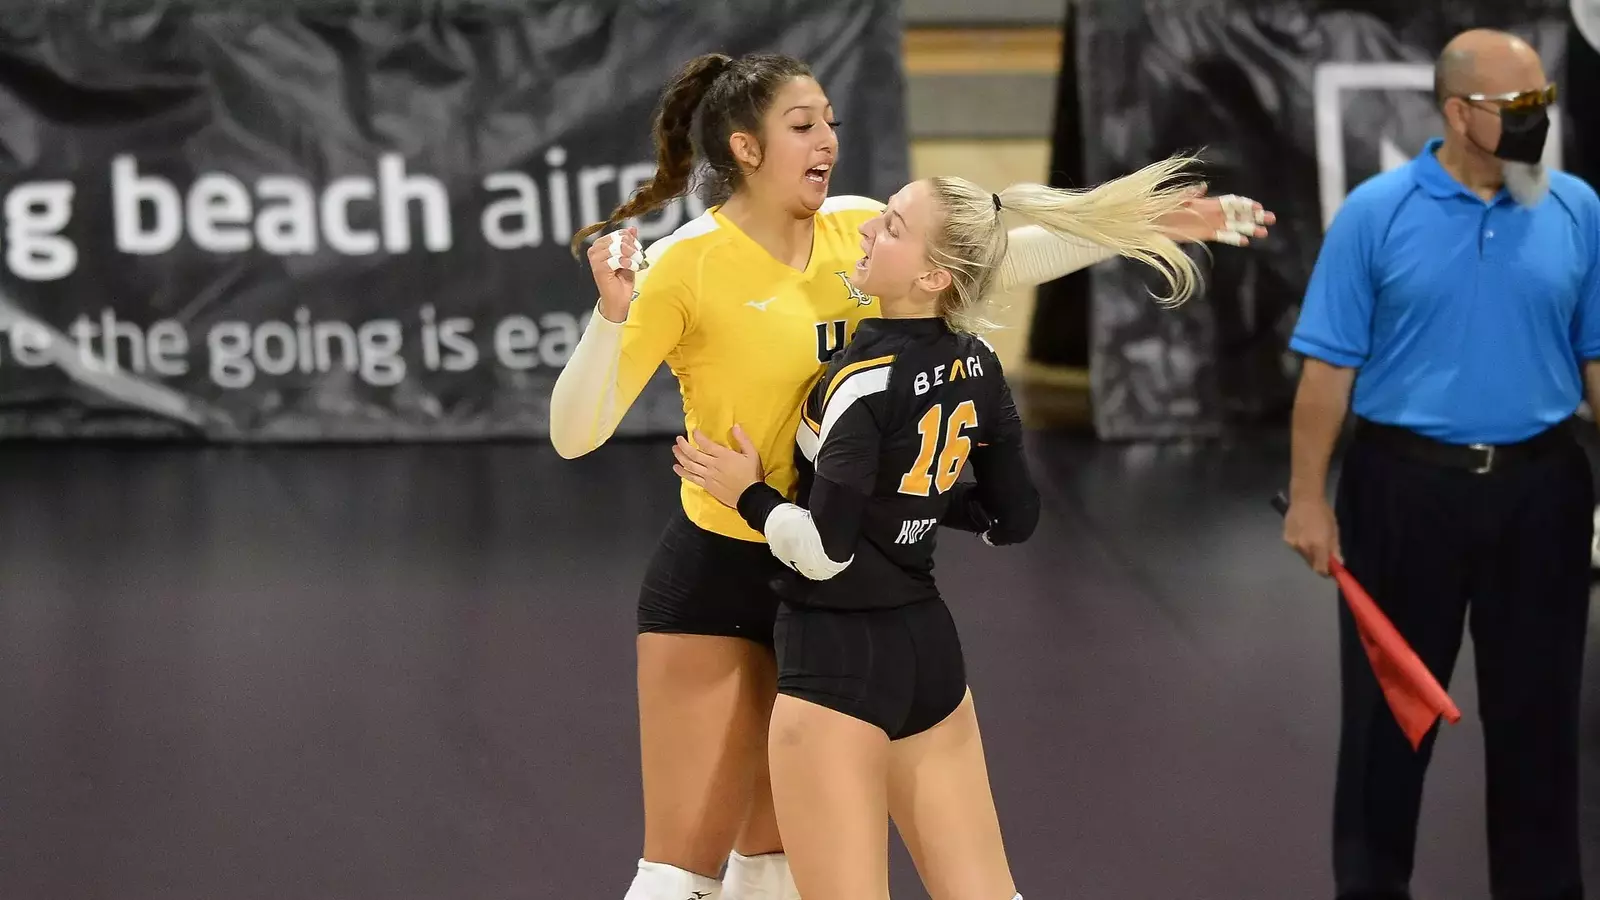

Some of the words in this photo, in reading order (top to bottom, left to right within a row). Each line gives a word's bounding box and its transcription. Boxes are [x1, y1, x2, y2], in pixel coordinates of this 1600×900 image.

[111, 154, 452, 255] beach
[481, 147, 708, 249] airp
[70, 306, 190, 376] the
[208, 305, 406, 388] going
[419, 303, 479, 371] is
[913, 355, 984, 396] BEACH
[897, 399, 979, 497] 16
